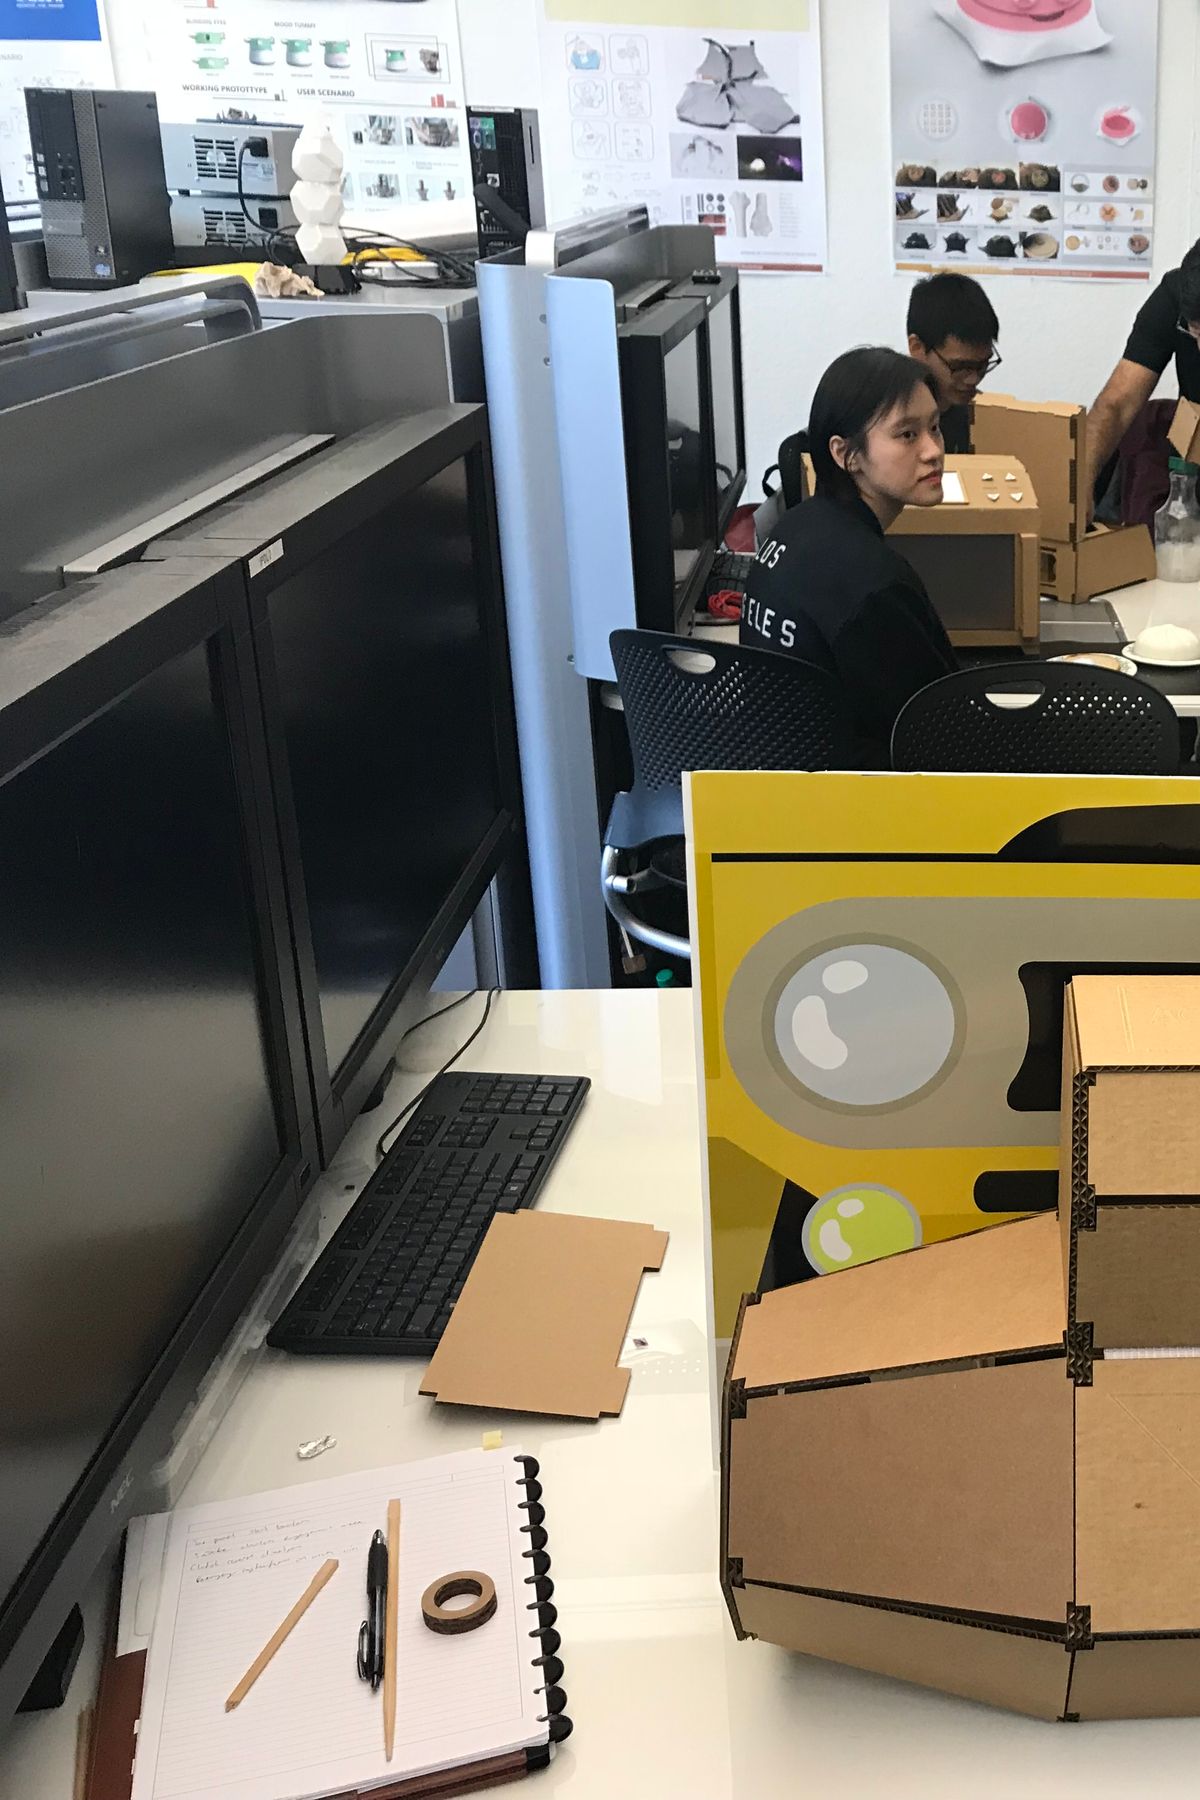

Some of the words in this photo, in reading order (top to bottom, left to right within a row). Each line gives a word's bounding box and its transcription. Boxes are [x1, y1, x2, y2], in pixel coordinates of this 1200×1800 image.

[182, 84, 220, 92] WORKING
[296, 88, 316, 96] USER
[317, 90, 356, 98] SCENARIO
[741, 592, 797, 648] ELES
